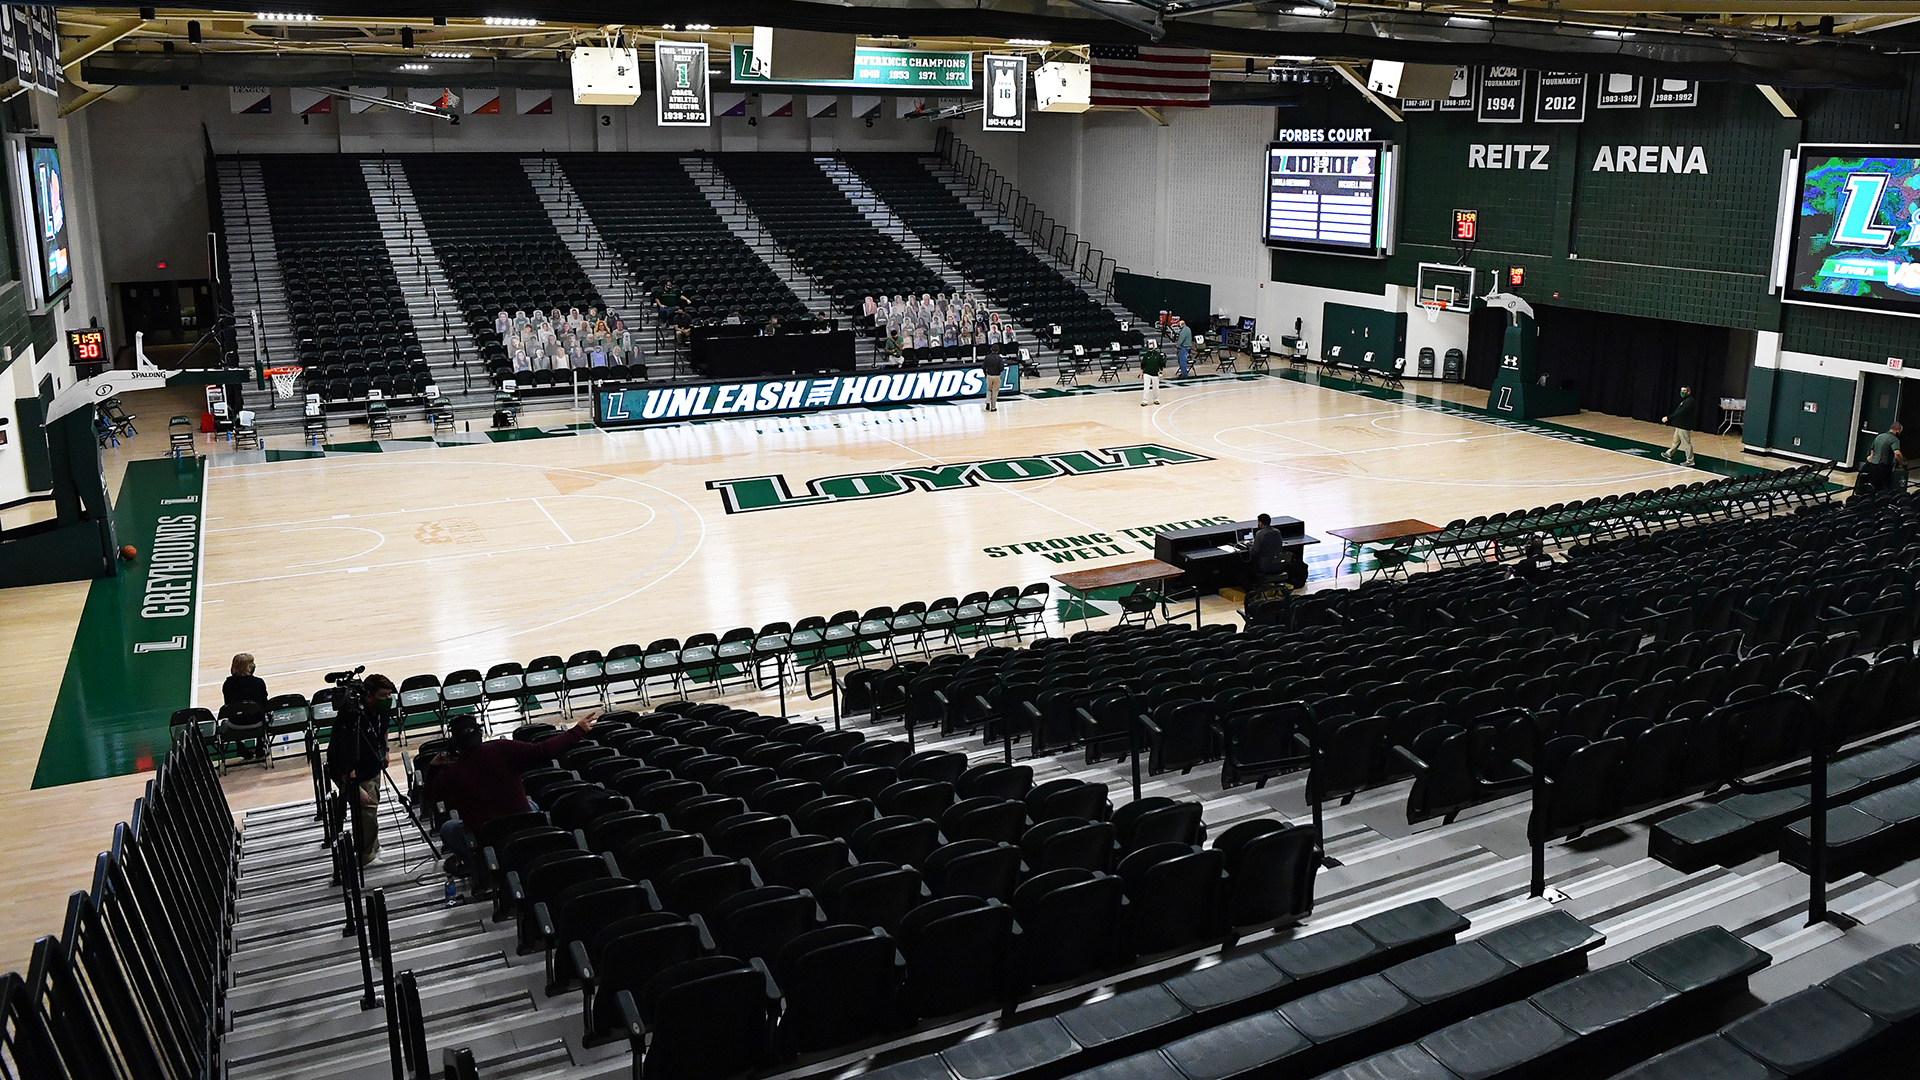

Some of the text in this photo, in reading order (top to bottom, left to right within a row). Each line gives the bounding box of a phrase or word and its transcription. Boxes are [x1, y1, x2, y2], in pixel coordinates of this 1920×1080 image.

[854, 55, 966, 68] NFERENCE CHAMPIONS
[676, 63, 690, 88] 1
[919, 71, 937, 80] 1971
[946, 72, 965, 80] 1973
[1489, 66, 1518, 78] NCAA
[1485, 79, 1521, 87] TOURNAMENT
[1542, 77, 1582, 86] TOURNAMENT
[999, 88, 1011, 99] 16
[1602, 95, 1638, 103] 1983-1987
[1655, 93, 1693, 102] 1988-1992
[1486, 97, 1516, 111] 1994
[1544, 96, 1577, 111] 2012
[601, 116, 611, 127] 3
[1279, 128, 1372, 142] FORBES COURT
[1468, 144, 1708, 174] REITZ ARENA
[1456, 212, 1477, 222] 31:59
[1457, 221, 1474, 239] 30
[1834, 264, 1875, 277] LOYOLA
[1511, 275, 1522, 285] 30
[72, 332, 102, 345] 31:59
[79, 344, 99, 358] 30
[1889, 359, 1901, 369] EXIT
[131, 371, 166, 379] SPALDING
[606, 392, 630, 420] L
[641, 379, 809, 419] UNLEASH
[804, 376, 839, 407] THE
[836, 368, 986, 405] HOUNDS
[1497, 386, 1514, 412] L
[705, 443, 1217, 515] LOYOLA
[982, 531, 1116, 559] STRONG
[1040, 543, 1136, 564] WELL
[140, 514, 198, 619] GREYHOUNDS
